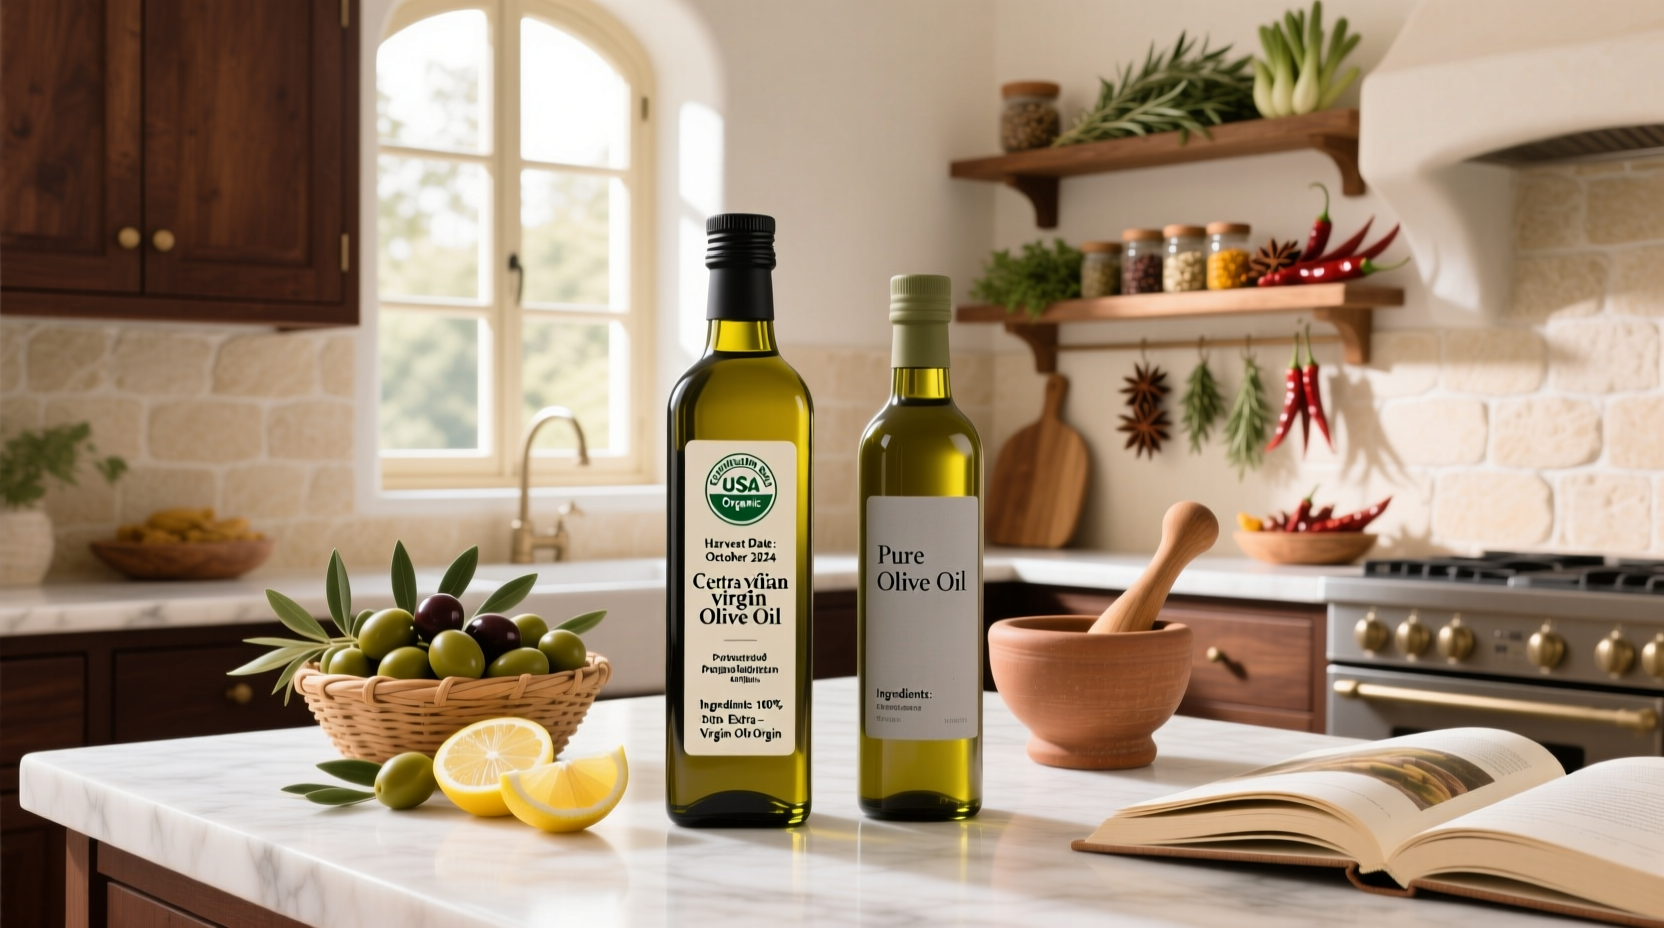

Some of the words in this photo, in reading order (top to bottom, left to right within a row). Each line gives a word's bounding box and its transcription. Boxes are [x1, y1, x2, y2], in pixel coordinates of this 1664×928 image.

[723, 476, 760, 493] USA
[722, 497, 761, 511] Organic
[705, 538, 745, 548] Harvest
[705, 552, 748, 562] October
[877, 545, 925, 564] Pure
[877, 571, 930, 591] Olive
[936, 570, 967, 591] Oil
[711, 590, 767, 611] virgin
[699, 607, 748, 625] Olive
[753, 607, 782, 625] Oil
